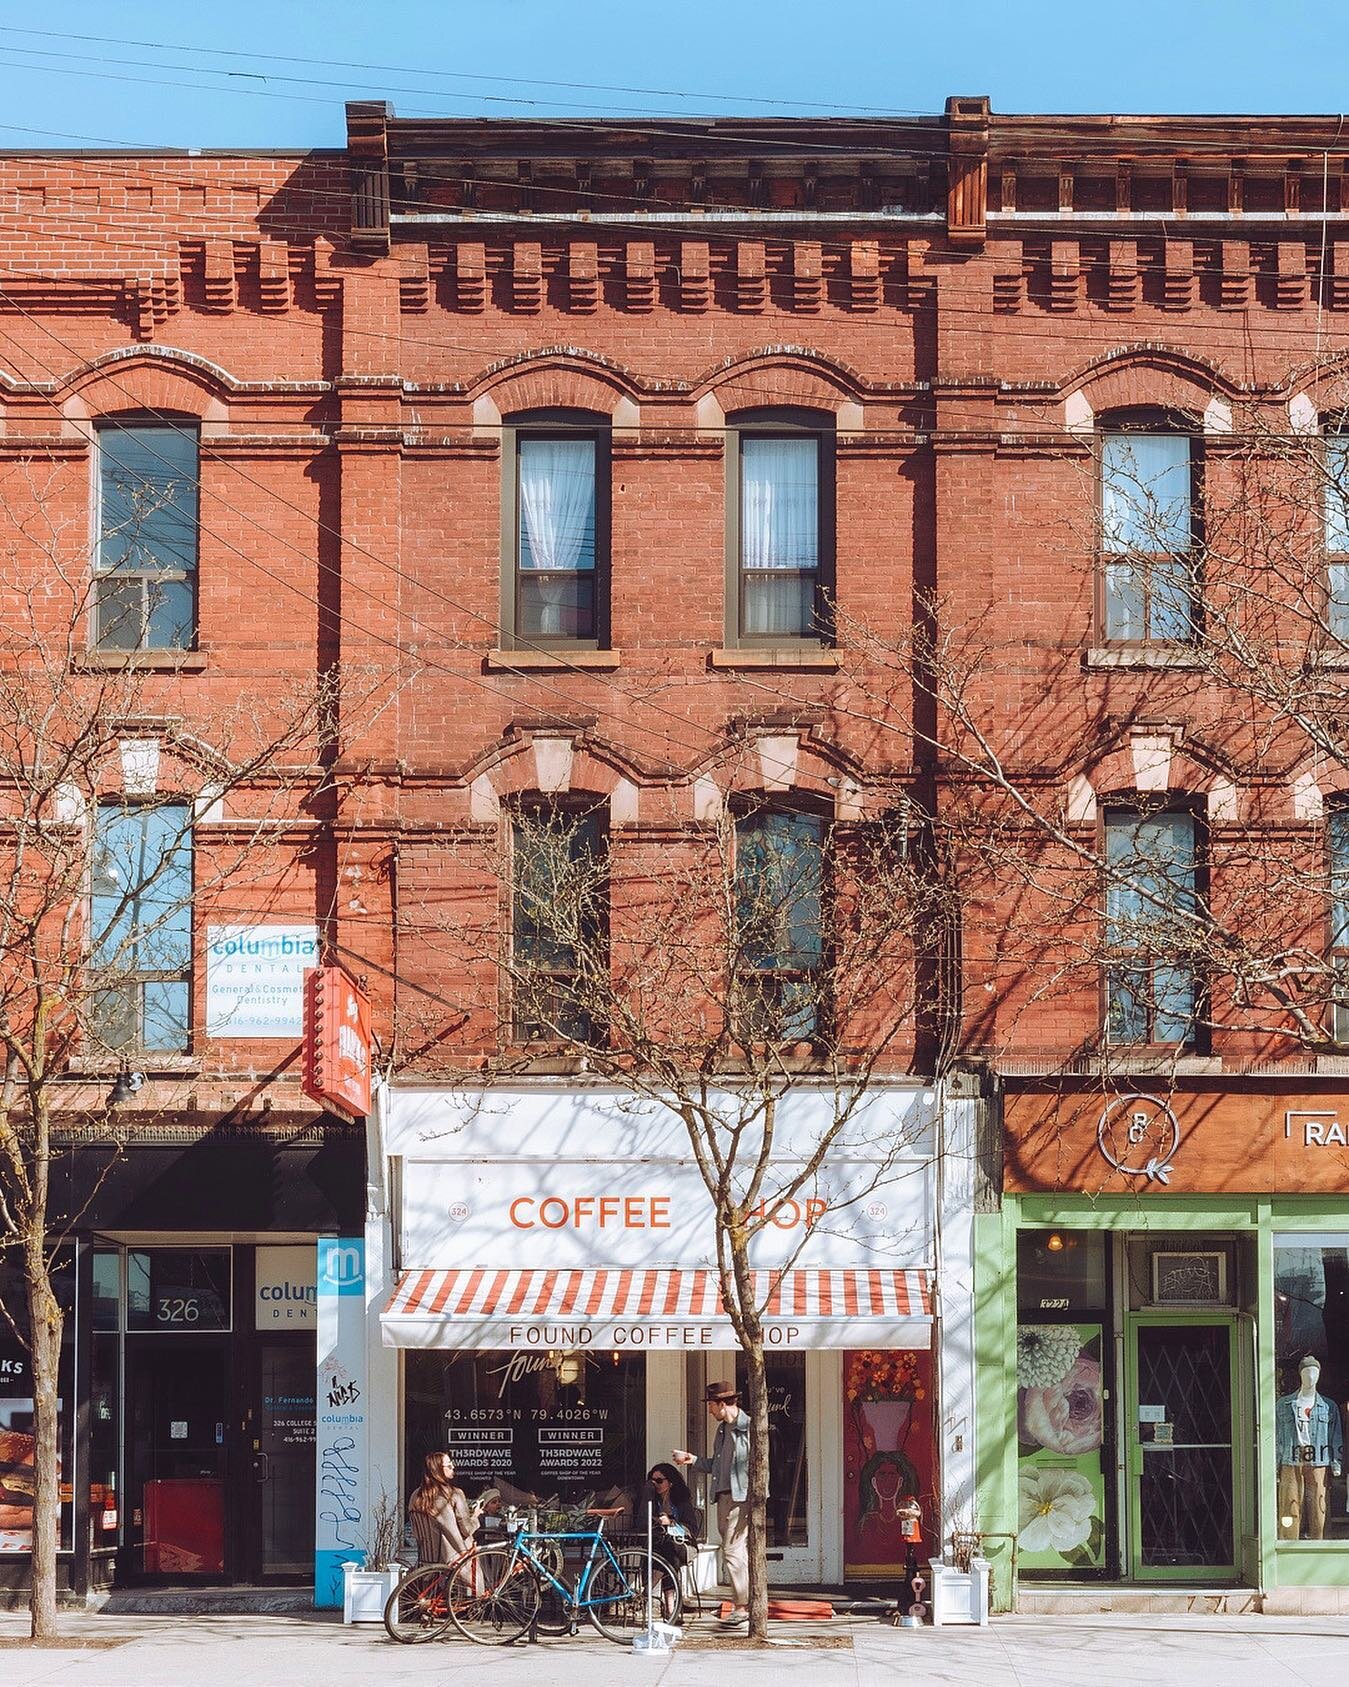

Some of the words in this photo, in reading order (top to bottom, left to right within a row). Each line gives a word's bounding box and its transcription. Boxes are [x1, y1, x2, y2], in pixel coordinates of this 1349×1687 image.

[213, 935, 314, 956] columbia
[226, 964, 303, 973] DENTAL
[237, 996, 288, 1006] Dentistry
[229, 1016, 302, 1026] 16-962-9942
[1305, 1122, 1349, 1146] RA
[451, 1207, 467, 1217] 324
[509, 1197, 671, 1229] COFFEE
[744, 1198, 828, 1230] HOP
[869, 1205, 886, 1216] 324
[157, 1299, 199, 1322] 326
[510, 1326, 592, 1344] FOUND
[613, 1326, 712, 1344] COFFEE
[321, 1414, 364, 1423] columbia
[444, 1409, 522, 1420] 43.6573°N
[530, 1409, 608, 1420] 79.4026°W
[457, 1432, 505, 1440] WINNER
[547, 1432, 595, 1440] WINNER
[450, 1449, 512, 1457] TH3RDWAVE
[539, 1449, 602, 1457] TH3RDWAVE
[491, 1459, 513, 1467] 2020
[539, 1459, 579, 1467] AWARDS
[581, 1459, 603, 1467] 2022
